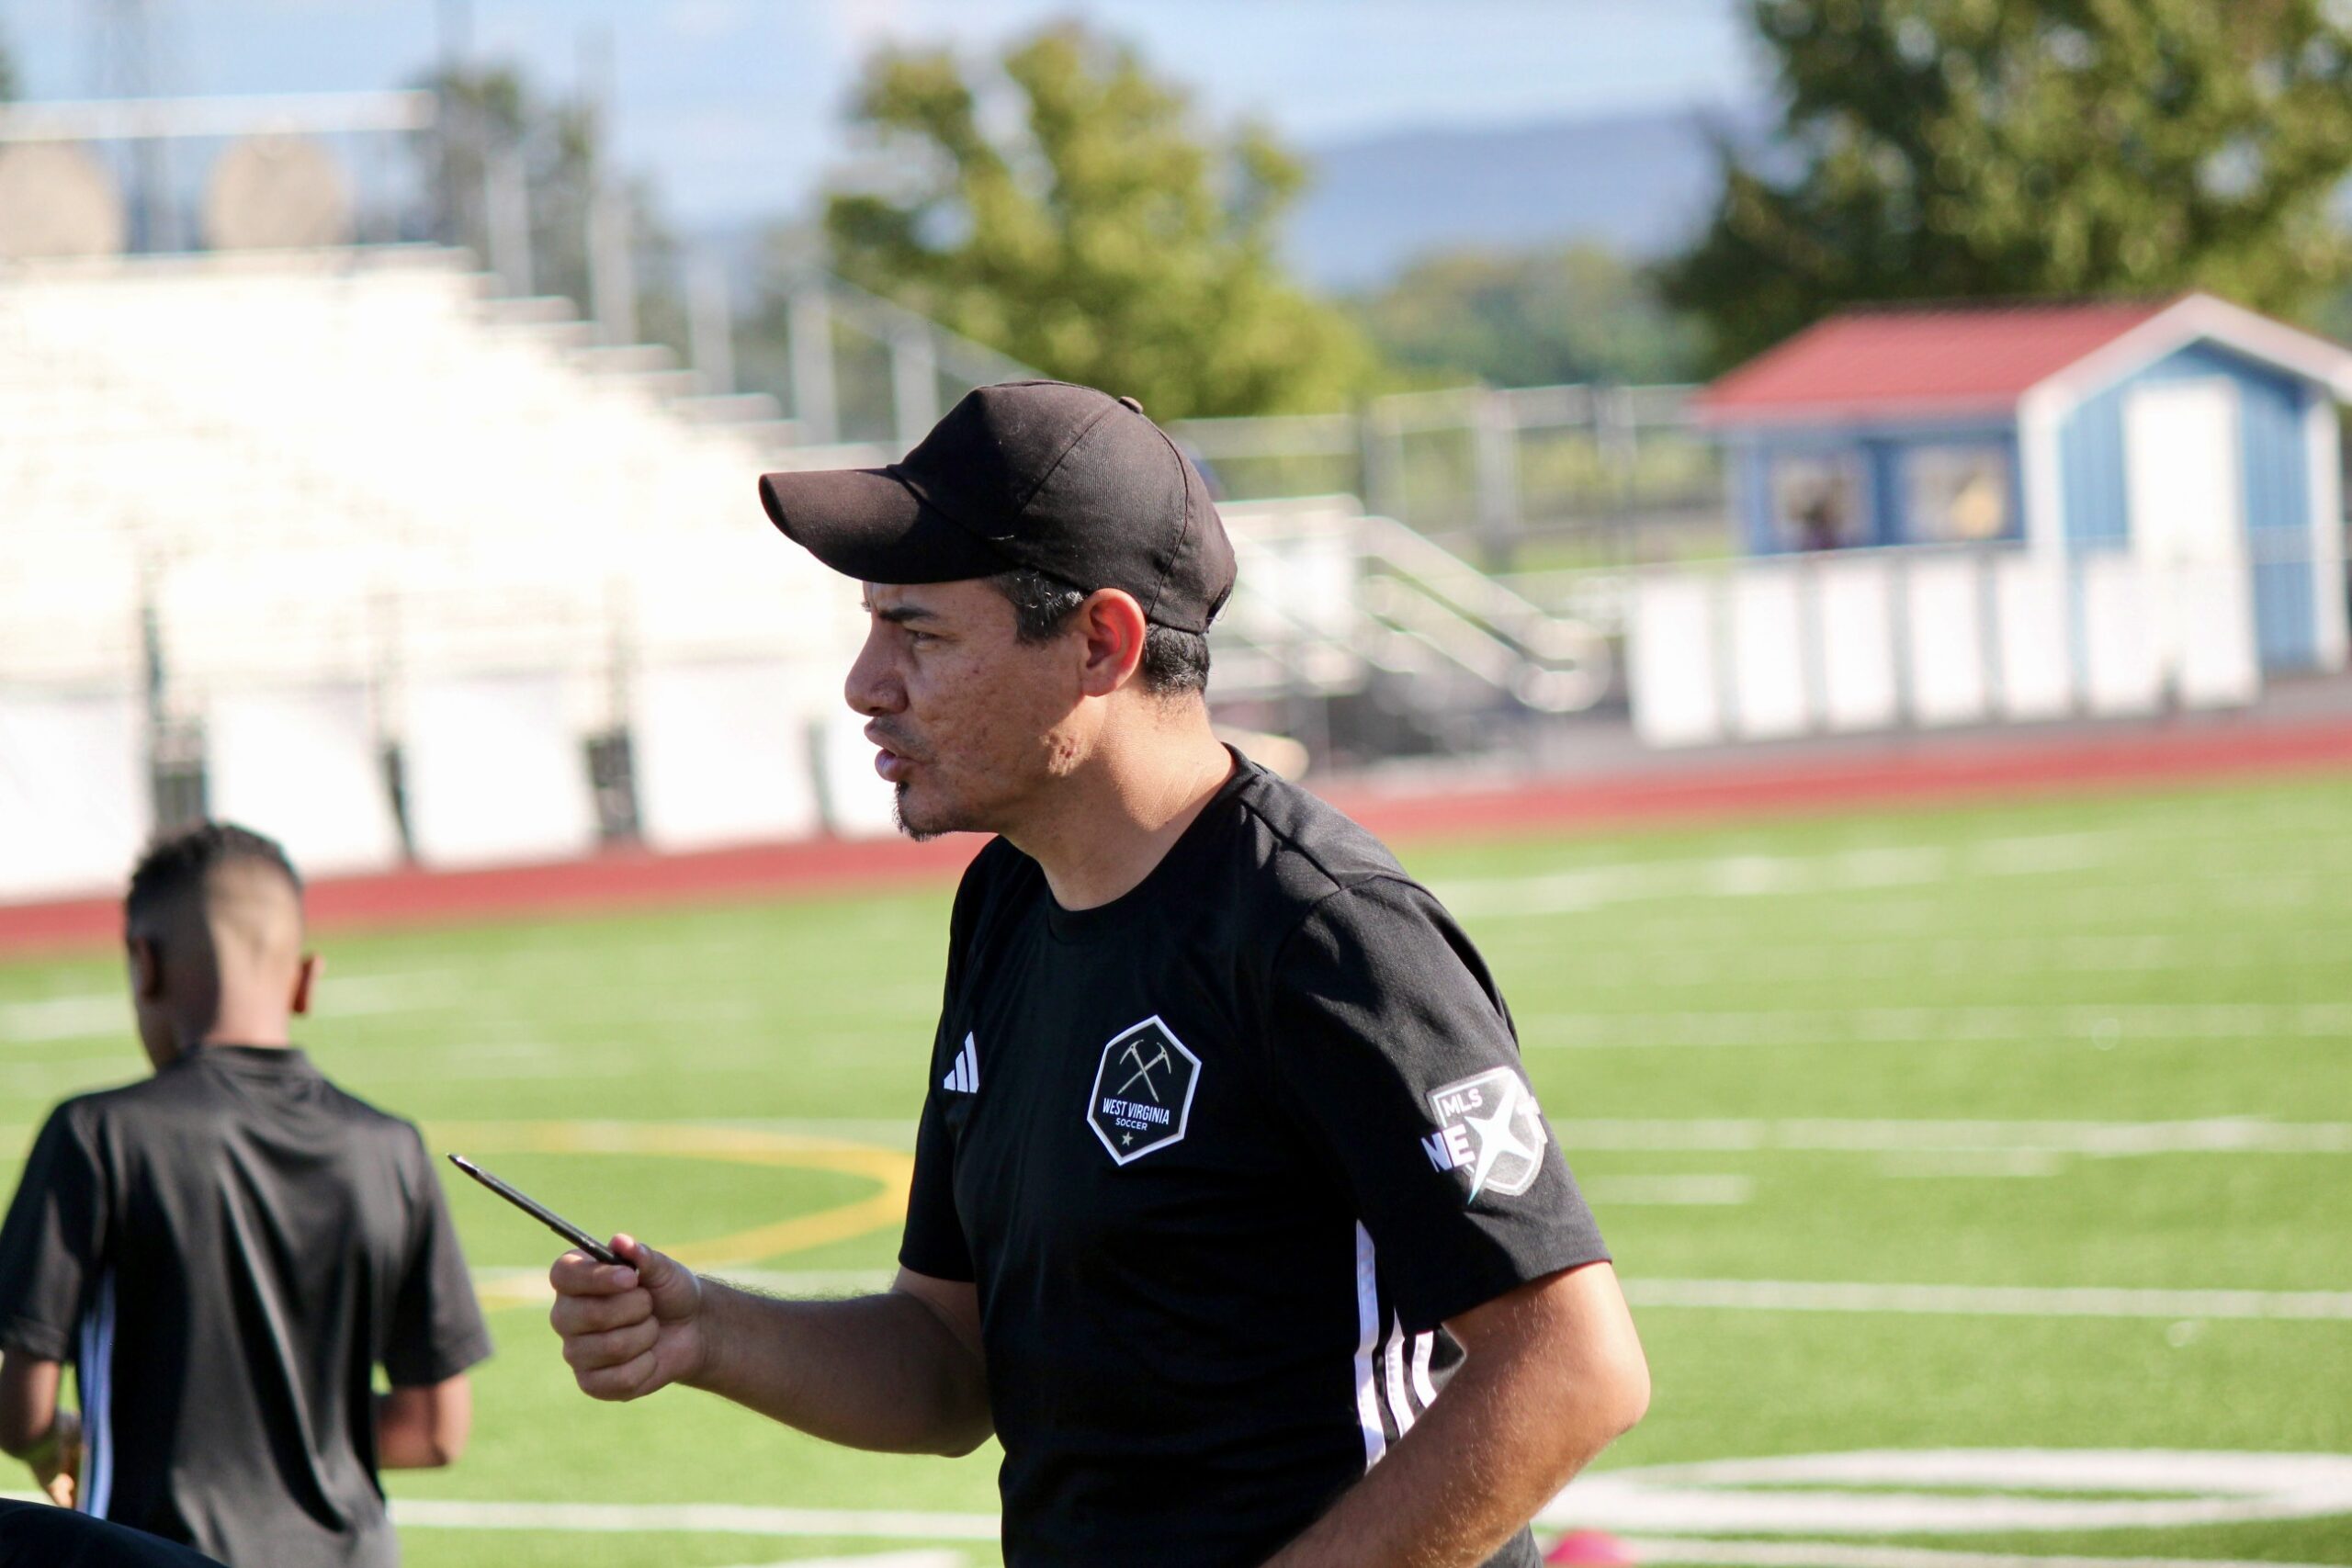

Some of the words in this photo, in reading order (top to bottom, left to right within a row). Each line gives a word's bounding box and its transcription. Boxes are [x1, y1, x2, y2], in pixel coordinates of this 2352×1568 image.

[1102, 1098, 1128, 1115] WEST
[1127, 1101, 1170, 1124] VIRGINIA
[1442, 1089, 1482, 1117] MLS
[1115, 1118, 1148, 1131] SOCCER
